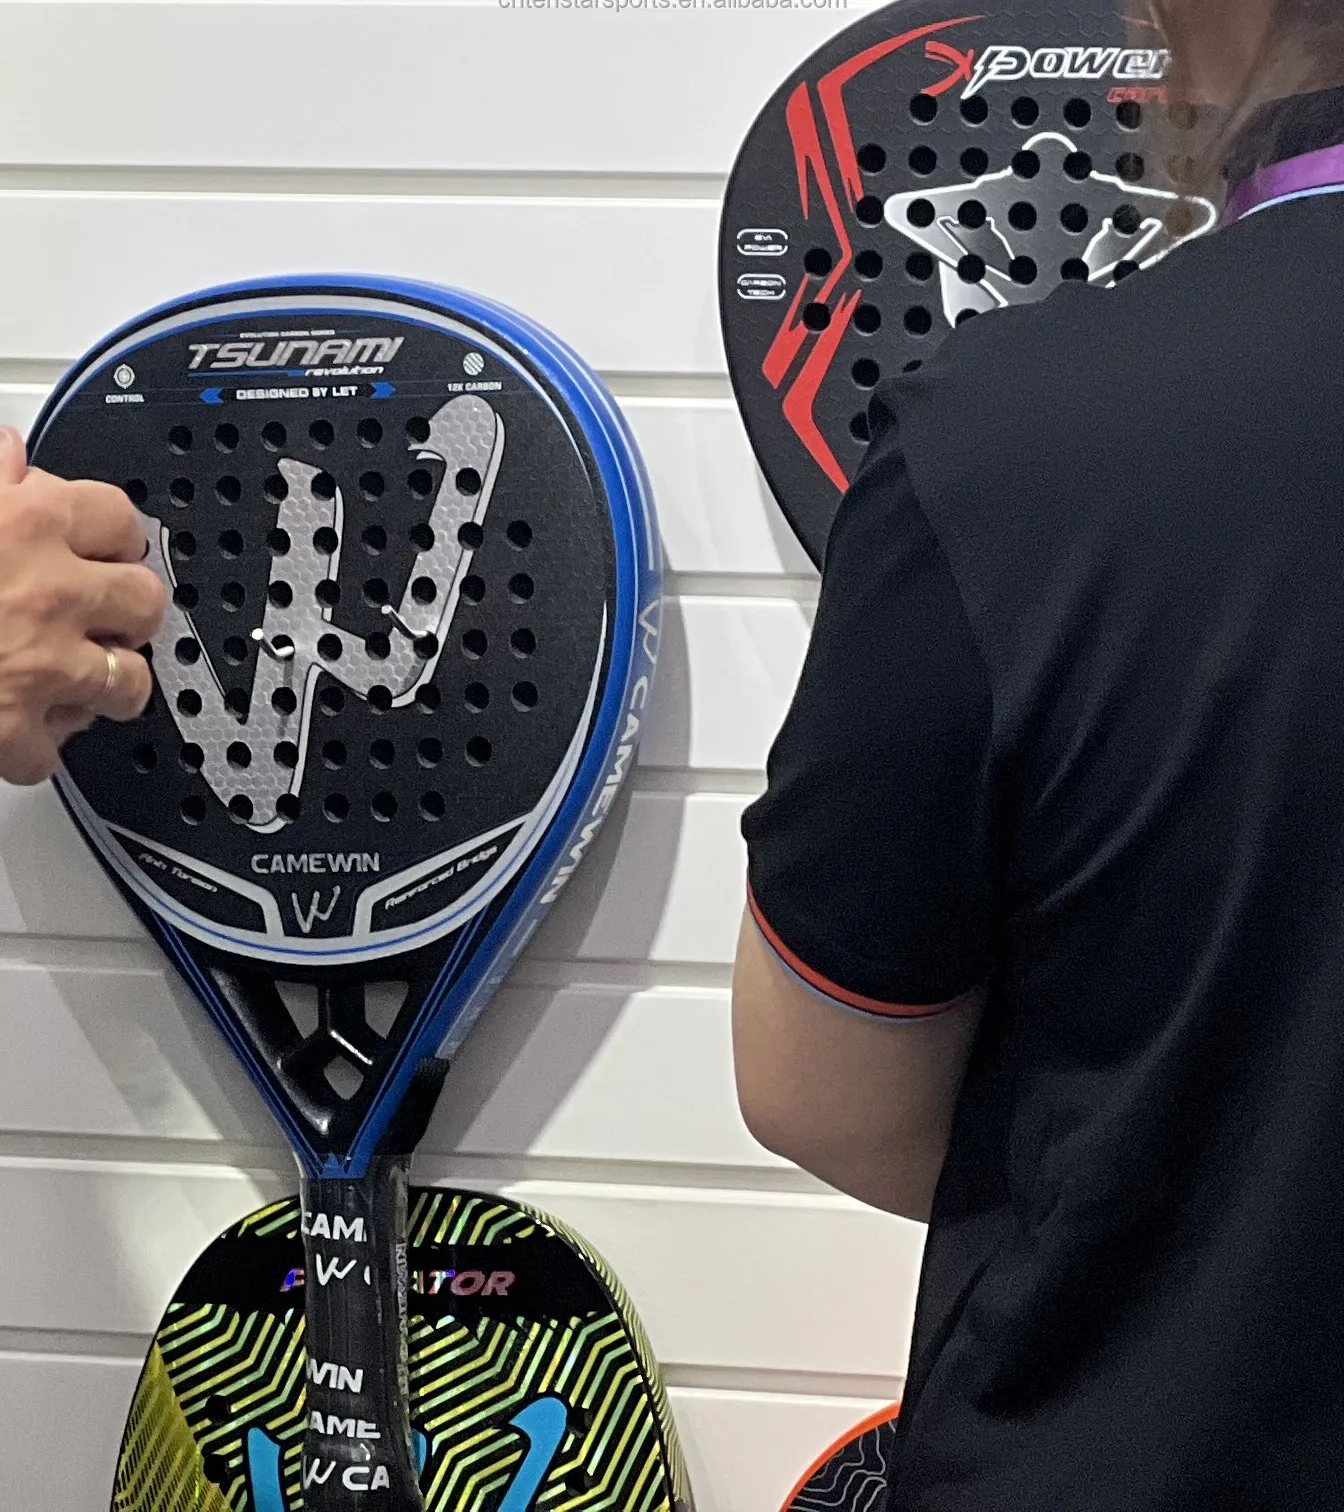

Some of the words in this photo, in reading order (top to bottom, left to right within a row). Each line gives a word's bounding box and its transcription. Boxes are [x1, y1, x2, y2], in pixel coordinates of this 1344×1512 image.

[187, 337, 405, 370] TSUNAMI
[305, 365, 385, 377] revolution
[236, 389, 309, 400] DESIGNED
[312, 387, 328, 397] BY
[332, 386, 358, 396] LET
[464, 381, 503, 391] CARBON
[105, 394, 145, 404] CONTROL
[539, 674, 650, 906] CAMEWIN
[250, 851, 380, 874] CAMEWIN
